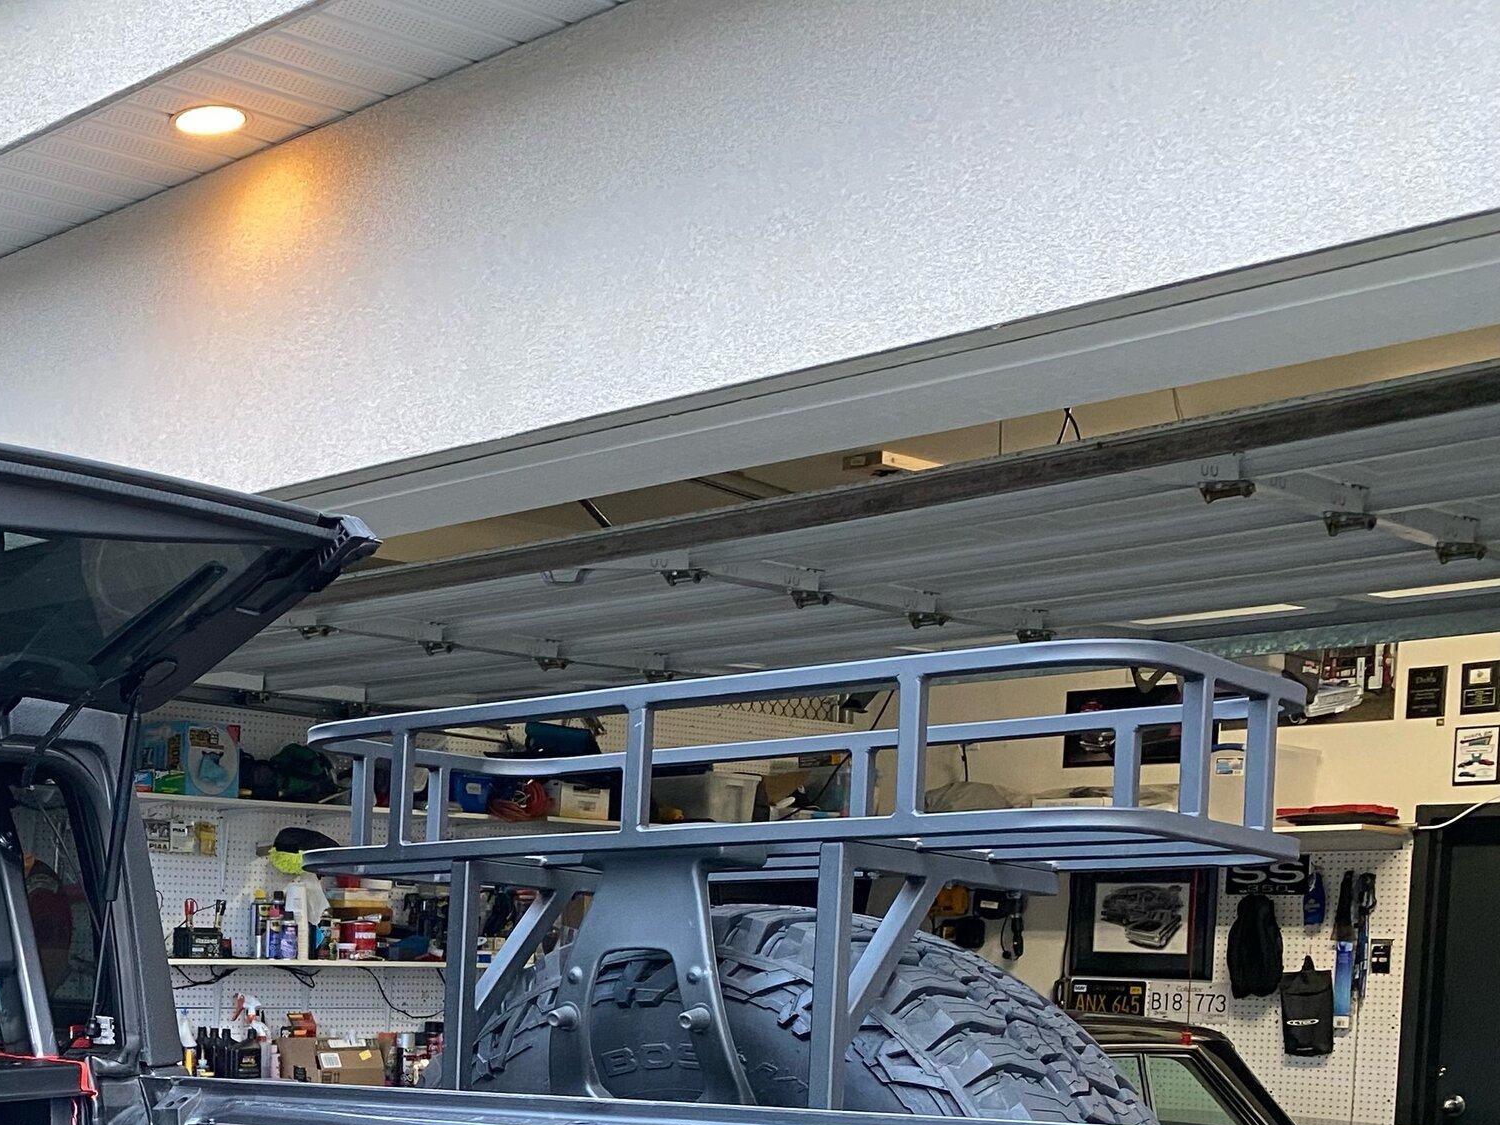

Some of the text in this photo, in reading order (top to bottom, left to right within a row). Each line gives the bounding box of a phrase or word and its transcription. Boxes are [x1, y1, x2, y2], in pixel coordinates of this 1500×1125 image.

[1232, 861, 1305, 884] SS
[1075, 993, 1140, 1014] ANX 645
[1151, 992, 1226, 1013] B18 773
